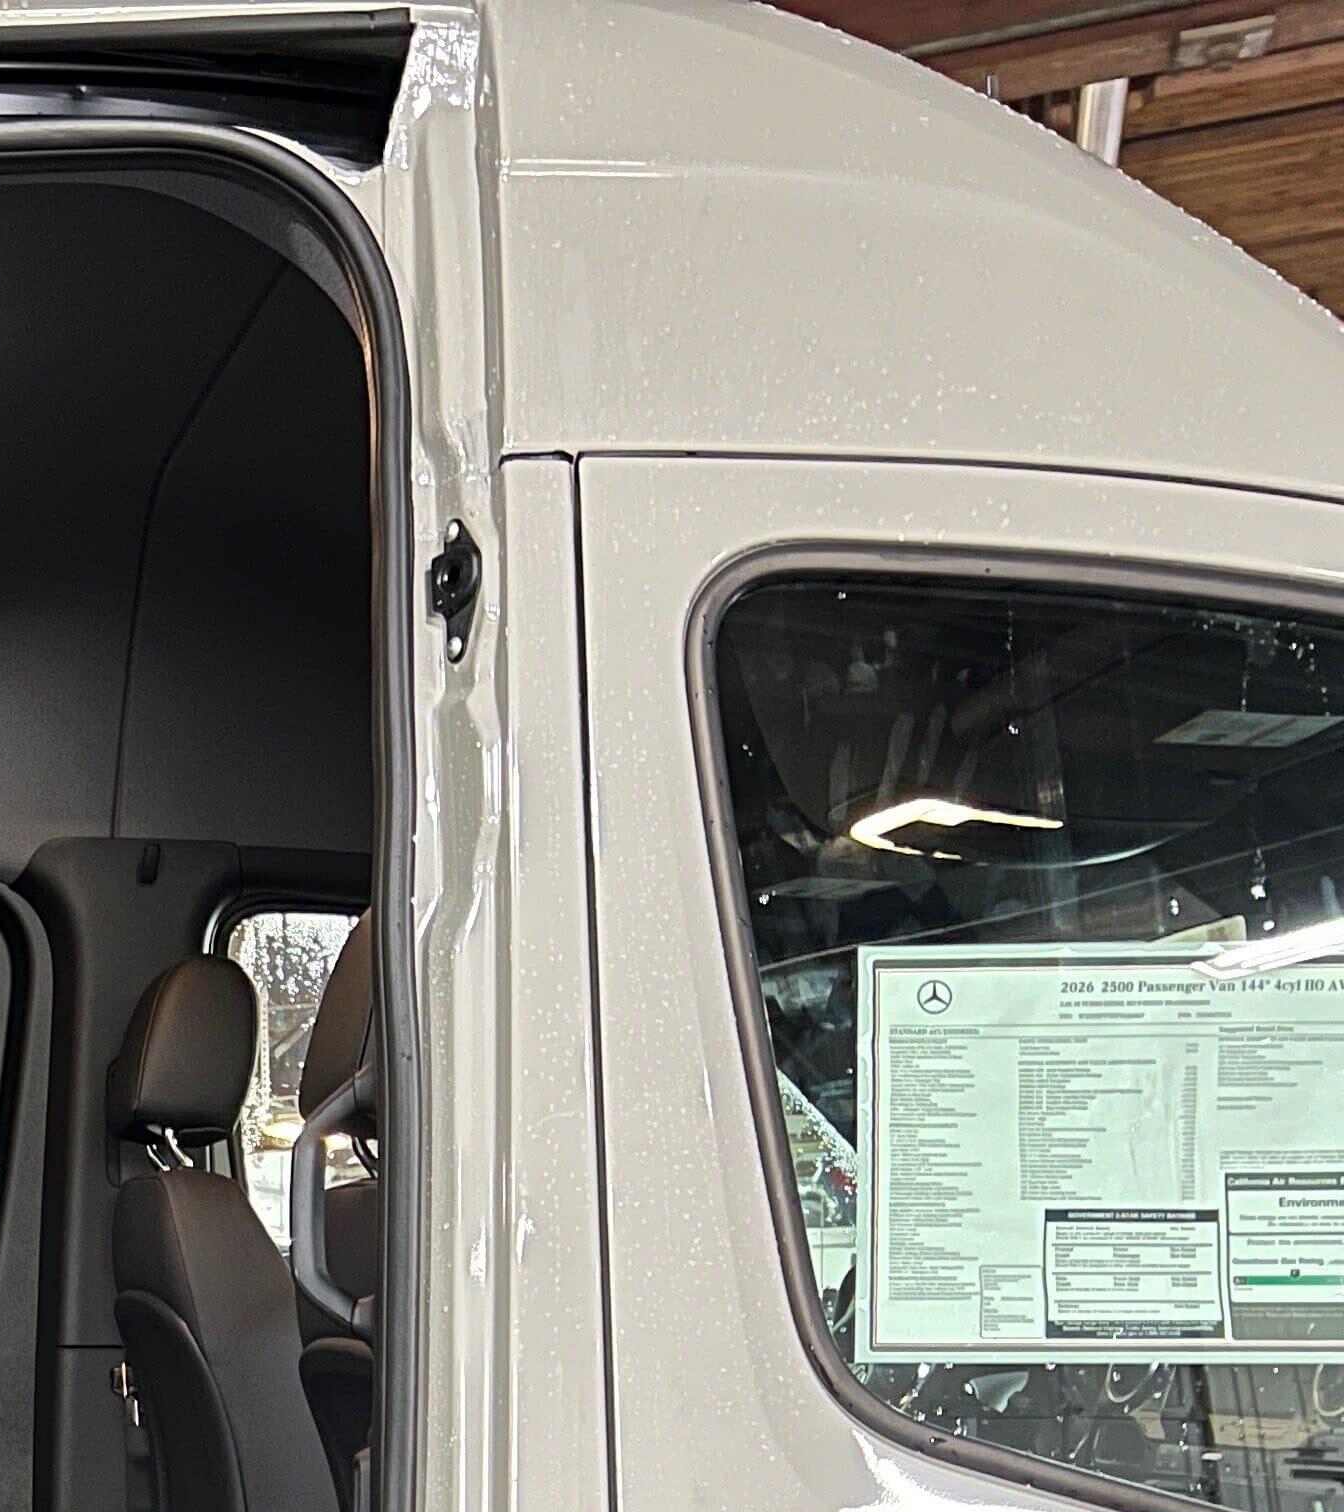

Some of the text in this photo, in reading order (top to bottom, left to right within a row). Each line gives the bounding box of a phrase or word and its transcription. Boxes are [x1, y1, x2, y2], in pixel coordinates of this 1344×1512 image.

[1060, 981, 1095, 994] 2026
[1101, 980, 1134, 993] 2500
[1137, 980, 1205, 994] Passenger
[1208, 979, 1236, 992] Van
